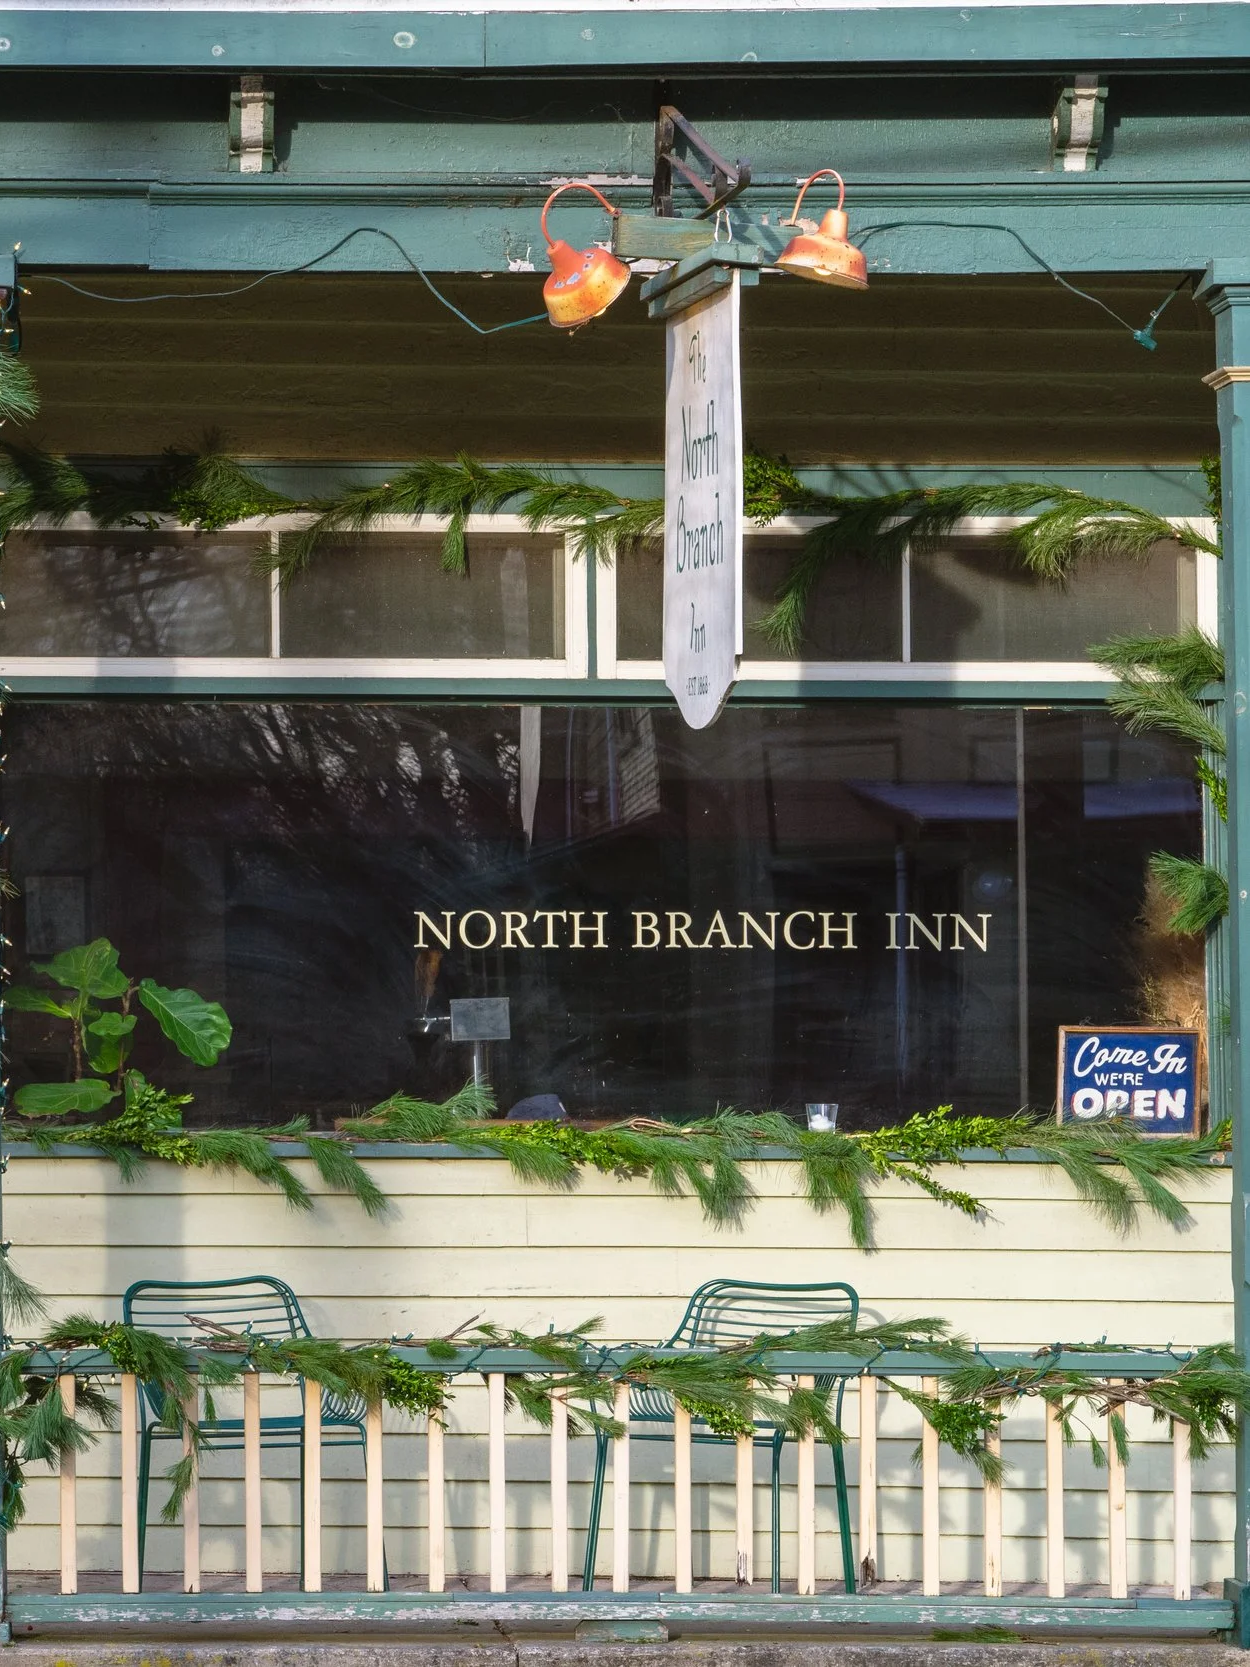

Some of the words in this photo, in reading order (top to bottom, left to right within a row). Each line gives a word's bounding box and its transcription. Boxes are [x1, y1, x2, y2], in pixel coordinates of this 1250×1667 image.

[688, 330, 707, 384] The
[681, 400, 720, 483] North
[676, 492, 724, 574] Branch
[690, 602, 707, 653] Inn
[413, 910, 609, 950] NORTH
[631, 910, 858, 951] BRANCH
[885, 912, 993, 952] INN
[1073, 1036, 1149, 1078] Come
[1147, 1044, 1187, 1074] In
[1094, 1072, 1144, 1087] WE'RE
[1071, 1087, 1187, 1120] OPEN
